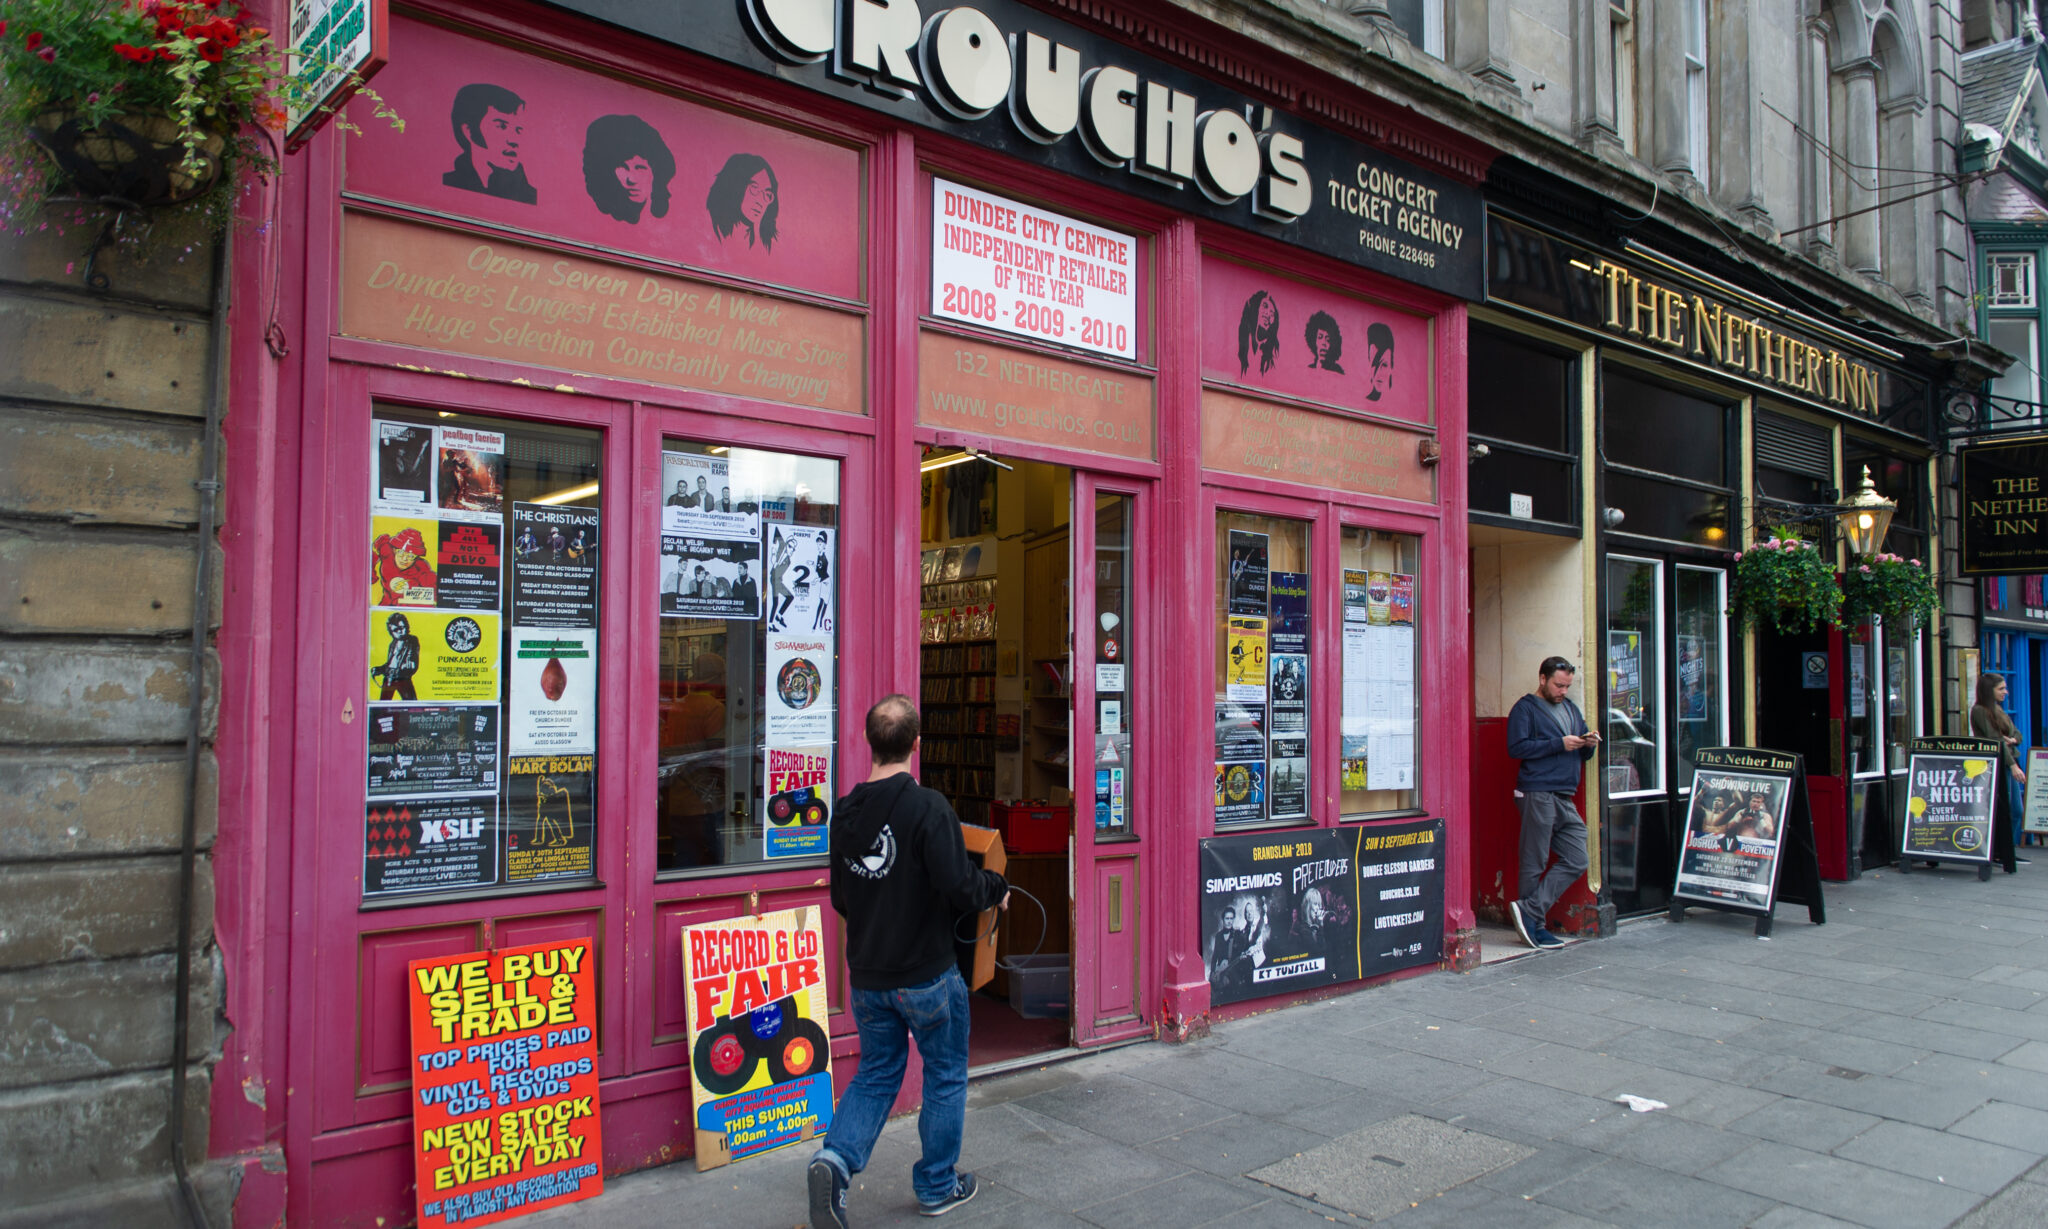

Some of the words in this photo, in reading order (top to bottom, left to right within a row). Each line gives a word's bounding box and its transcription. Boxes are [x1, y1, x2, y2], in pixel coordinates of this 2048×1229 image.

[329, 2, 364, 63] STORE
[1357, 162, 1438, 214] CONCERT
[944, 190, 1017, 234] DUNDEE
[1022, 213, 1060, 246] CITY
[1065, 226, 1127, 266] CENTRE
[1328, 179, 1392, 226] TICKET
[1397, 206, 1463, 250] AGENCY
[944, 222, 1054, 276] INDEPENDENT
[1059, 255, 1127, 296] RETAILER
[1359, 229, 1397, 256] PHONE
[1399, 243, 1435, 269] 228496
[467, 245, 540, 280] Open
[548, 261, 628, 297] Seven
[637, 277, 699, 313] Days
[704, 292, 722, 316] A
[728, 295, 782, 328] Week
[994, 264, 1012, 290] OF
[1017, 270, 1045, 299] THE
[1050, 279, 1084, 309] YEAR
[367, 260, 496, 308] Dundee's
[504, 286, 597, 324] Longest
[602, 302, 724, 347] Established
[731, 327, 791, 359] Music
[795, 338, 849, 370] Store
[943, 282, 996, 322] 2008
[1014, 300, 1064, 337] 2009
[1081, 316, 1126, 352] 2010
[404, 303, 476, 343] Huge
[484, 317, 595, 359] Selection
[606, 336, 729, 385] Constantly
[738, 359, 830, 403] Changing
[1600, 259, 1684, 348] THE
[1692, 294, 1825, 398] NETHER
[1828, 350, 1879, 417] INN
[954, 349, 989, 377] 132
[999, 358, 1125, 404] NETHERGATE
[1240, 401, 1273, 423] Good
[1275, 408, 1314, 434] Quality
[442, 429, 473, 443] peatbog
[1342, 465, 1399, 491] Exchanged
[1992, 477, 2040, 495] THE
[514, 509, 533, 521] THE
[535, 511, 598, 526] CHRISTIANS
[1970, 497, 2048, 517] NETHE
[1994, 519, 2039, 535] INN
[450, 554, 486, 565] DEVO
[437, 655, 488, 665] PUNKADELIC
[769, 749, 804, 772] RECORD
[807, 755, 813, 771] &
[816, 756, 827, 770] CD
[1700, 751, 1721, 763] The
[1724, 753, 1768, 768] Nether
[1770, 757, 1793, 769] Inn
[1913, 740, 1934, 750] The
[1937, 741, 1975, 751] Nether
[1978, 742, 1998, 752] Inn
[509, 761, 547, 775] MARC
[549, 760, 593, 774] BOLAN
[769, 770, 827, 796] FAIR
[1917, 769, 1958, 787] QUIZ
[1710, 777, 1750, 792] SHOWING
[1750, 781, 1771, 794] LIVE
[1930, 786, 1984, 804] NIGHT
[1928, 814, 1959, 823] MONDAY
[1931, 806, 1955, 815] EVERY
[420, 817, 485, 844] XSLF
[1365, 837, 1379, 851] SUN
[1385, 832, 1418, 849] SEPTEMBER
[1417, 830, 1434, 844] 2018
[1687, 830, 1719, 850] JOSHUA
[1726, 837, 1734, 851] V
[1740, 843, 1775, 857] POVETKIN
[1963, 829, 1974, 838] £1
[1253, 846, 1293, 861] GRANDSLAM
[1296, 842, 1312, 857] 2018
[1363, 863, 1383, 878] DUNDEE
[1383, 861, 1409, 875] SLESSOR
[1408, 858, 1435, 873] GARDENS
[1292, 858, 1349, 894] PRETENDERS
[416, 959, 490, 995] WE
[503, 946, 586, 982] BUY
[690, 929, 770, 979] RECORD
[775, 930, 788, 962] &
[793, 930, 818, 959] CD
[1258, 968, 1272, 980] KT
[1276, 961, 1319, 976] TUNSTALL
[430, 979, 538, 1018] SELL
[550, 973, 576, 999] &
[693, 958, 820, 1032] FAIR
[432, 996, 576, 1044] TRADE
[418, 1049, 462, 1072] TOP
[467, 1034, 542, 1063] PRICES
[547, 1026, 591, 1049] PAID
[488, 1052, 529, 1075] FOR
[420, 1079, 485, 1106] VINYL
[490, 1057, 592, 1092] RECORDS
[447, 1096, 491, 1116] CDs
[497, 1089, 511, 1106] &
[517, 1080, 570, 1103] DVDs
[714, 1097, 738, 1111] CAIRD
[739, 1093, 757, 1104] HALL
[763, 1082, 797, 1098] MARRYAT
[797, 1077, 815, 1088] HALL
[724, 1106, 742, 1118] CITY
[776, 1088, 806, 1104] DUNDEE
[724, 1115, 755, 1134] THIS
[758, 1099, 809, 1125] SUNDAY
[423, 1117, 491, 1152] NEW
[499, 1096, 593, 1134] STOCK
[776, 1114, 818, 1132] 4.00pm
[449, 1138, 492, 1166] ON
[500, 1120, 570, 1154] SALE
[434, 1150, 524, 1191] EVERY
[533, 1135, 585, 1167] DAY
[424, 1201, 442, 1218] WE
[443, 1194, 471, 1212] ALSO
[472, 1189, 494, 1206] BUY
[494, 1184, 514, 1200] OLD
[515, 1173, 555, 1195] RECORD
[557, 1162, 597, 1183] PLAYERS
[445, 1209, 458, 1224] IN
[460, 1199, 505, 1223] (ALMOST)
[506, 1193, 527, 1209] ANY
[528, 1178, 580, 1203] CONDITION
